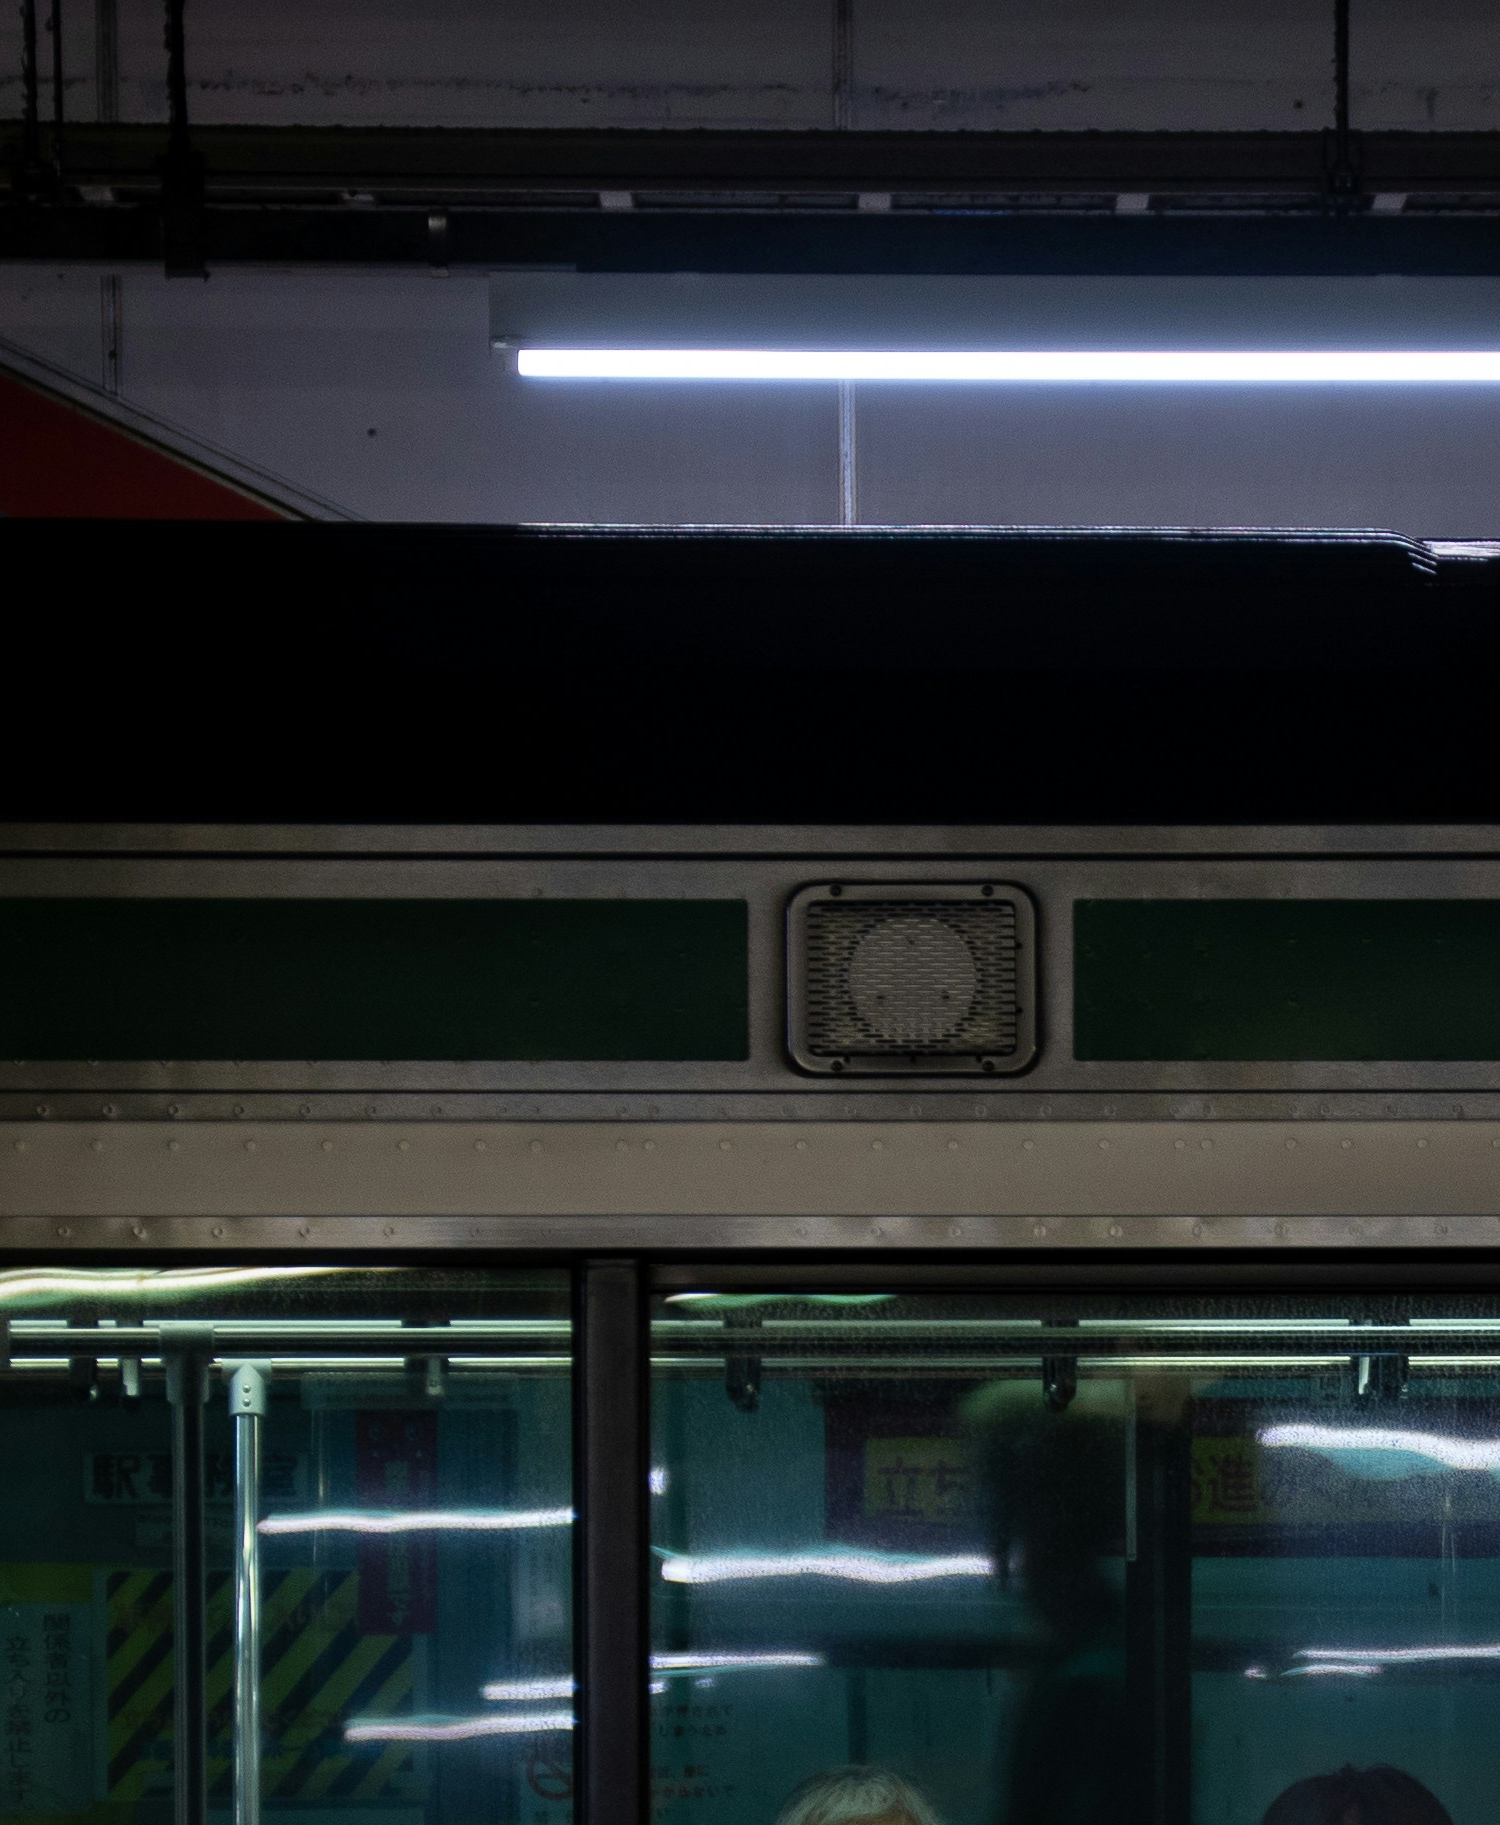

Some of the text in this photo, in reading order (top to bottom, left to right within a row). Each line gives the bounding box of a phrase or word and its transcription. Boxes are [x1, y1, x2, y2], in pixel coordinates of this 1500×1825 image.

[42, 1613, 73, 1724] 関係者以外の
